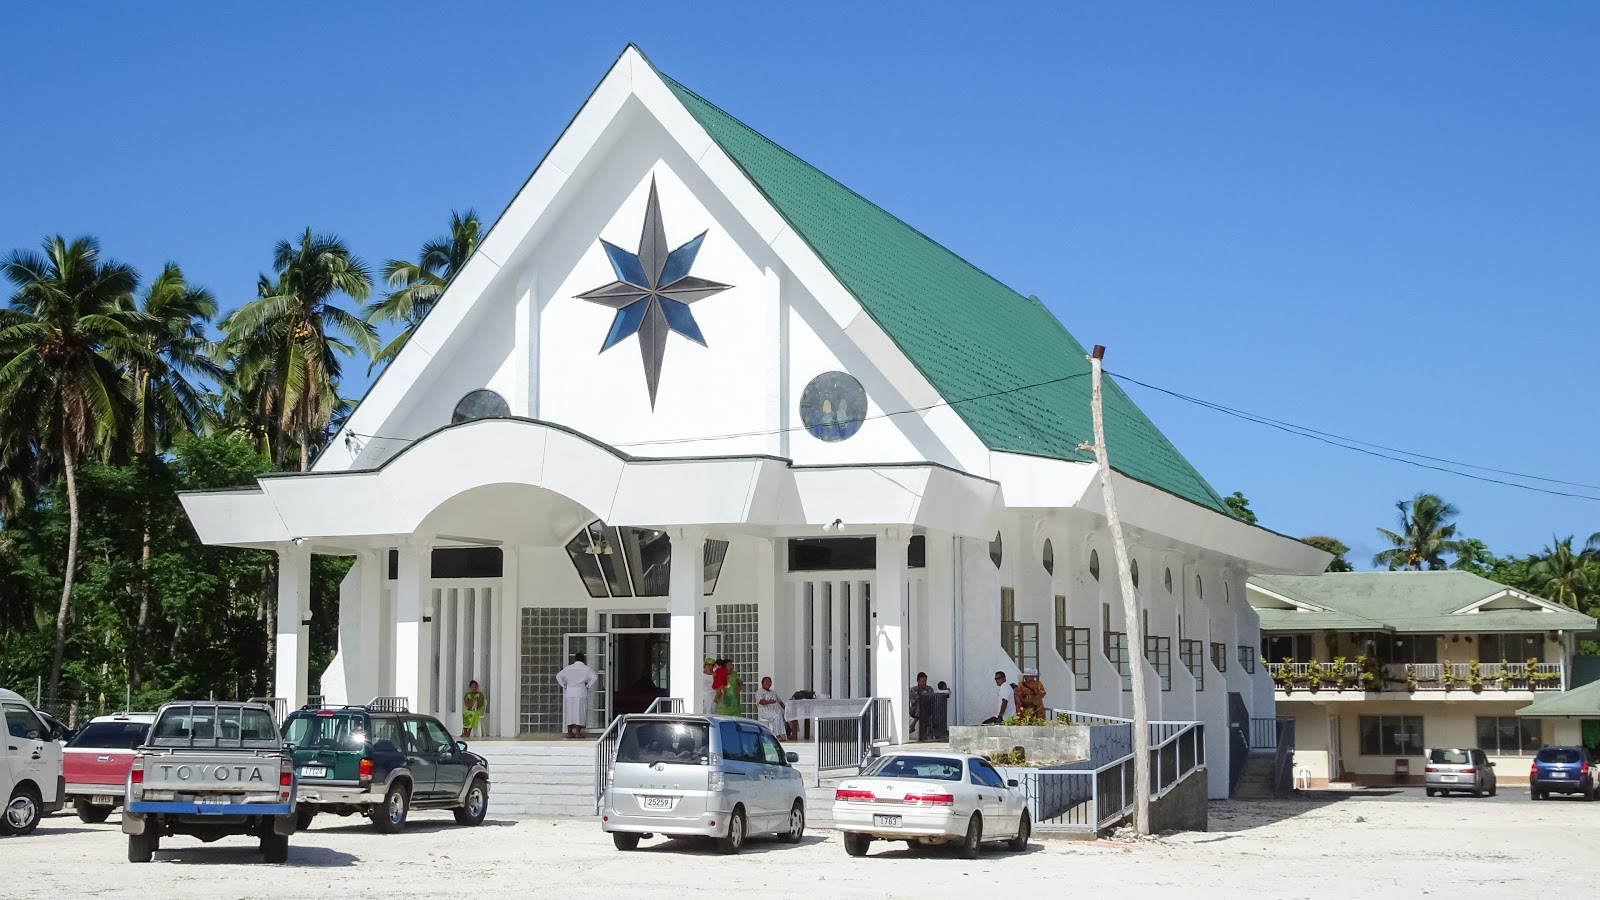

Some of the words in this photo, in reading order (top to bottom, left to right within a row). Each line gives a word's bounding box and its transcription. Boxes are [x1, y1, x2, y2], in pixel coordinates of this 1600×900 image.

[160, 764, 263, 782] TOYOTA
[648, 798, 669, 806] 25259
[880, 817, 897, 826] 1783
